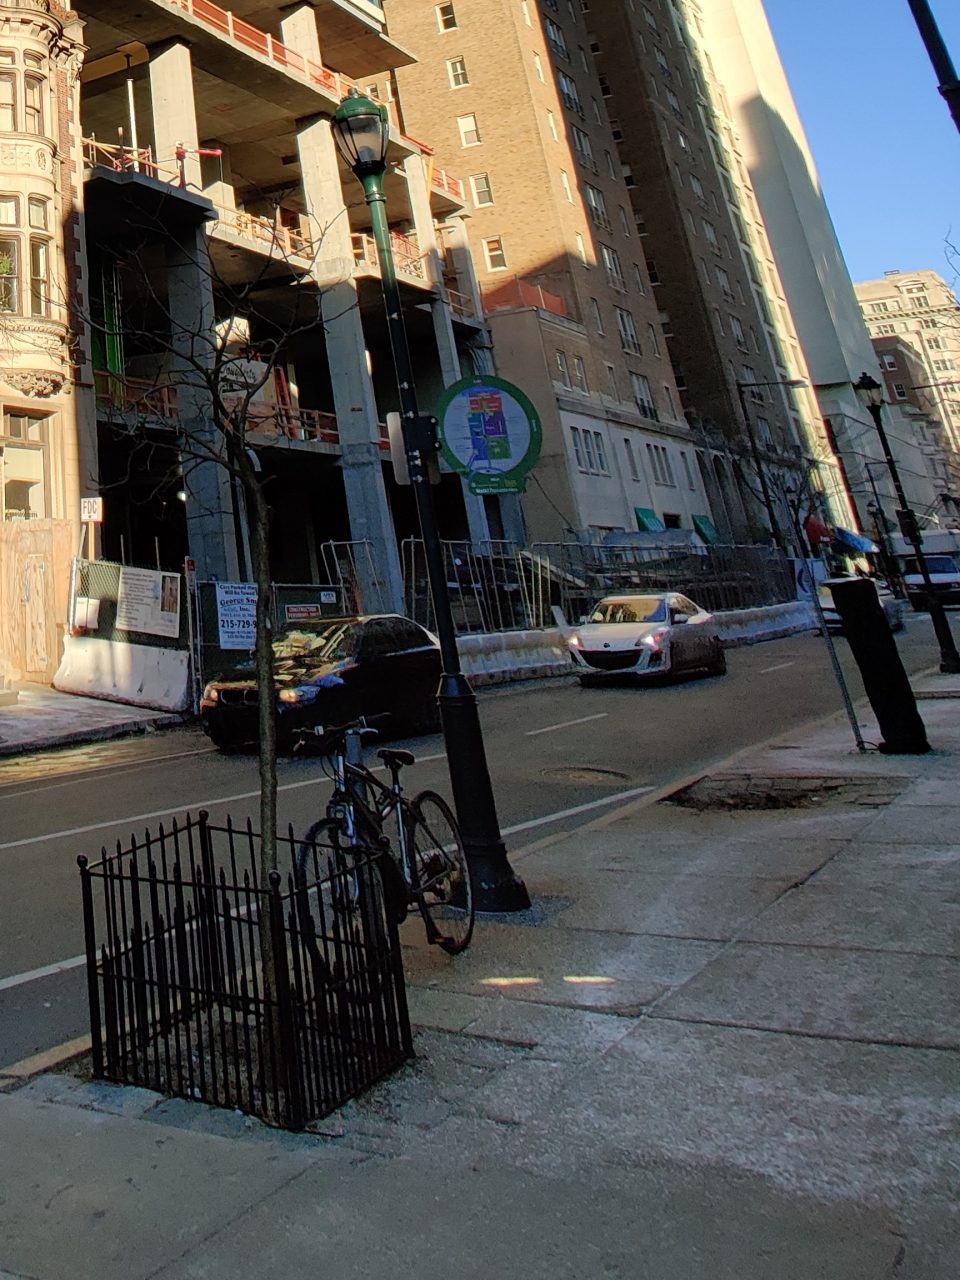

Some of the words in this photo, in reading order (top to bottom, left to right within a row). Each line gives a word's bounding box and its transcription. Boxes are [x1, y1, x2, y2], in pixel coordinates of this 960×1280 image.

[82, 500, 98, 515] FDC
[220, 598, 244, 607] George
[221, 619, 257, 629] 215-729-9
